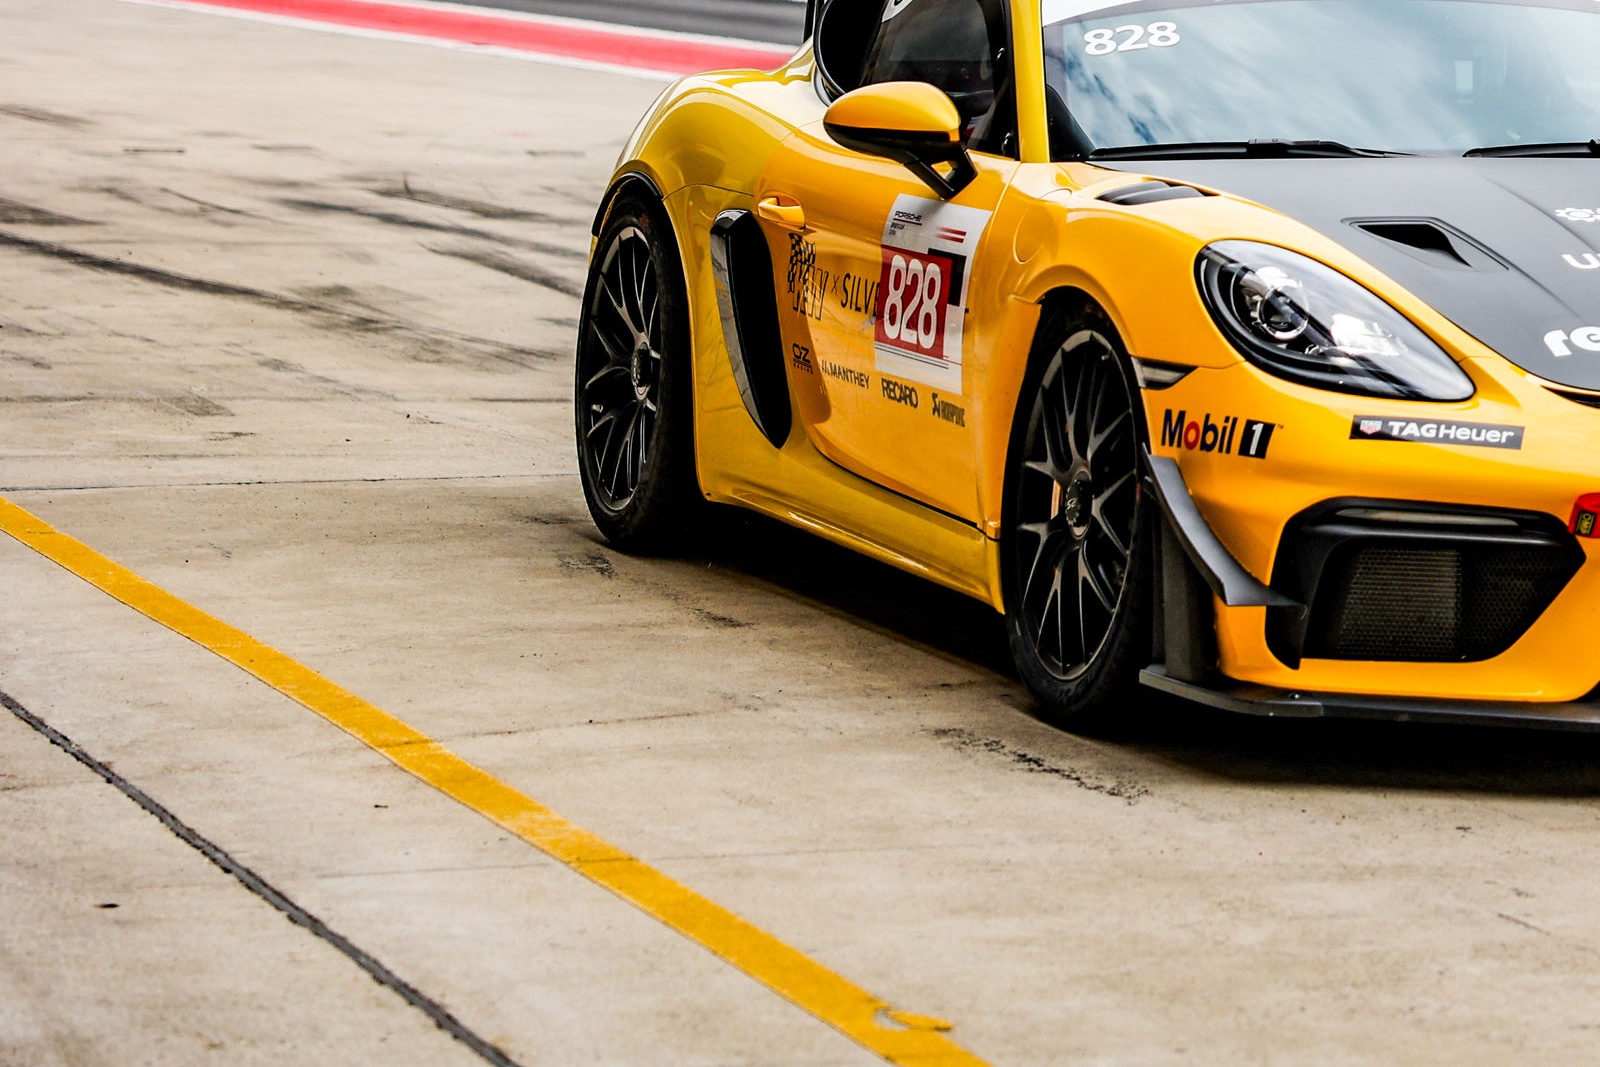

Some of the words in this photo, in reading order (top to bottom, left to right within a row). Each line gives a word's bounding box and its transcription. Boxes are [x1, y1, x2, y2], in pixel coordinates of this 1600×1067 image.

[1084, 21, 1180, 56] 828
[884, 254, 941, 349] 828
[881, 377, 919, 409] RECARO
[1161, 408, 1238, 455] Mobil
[1249, 423, 1264, 455] 1
